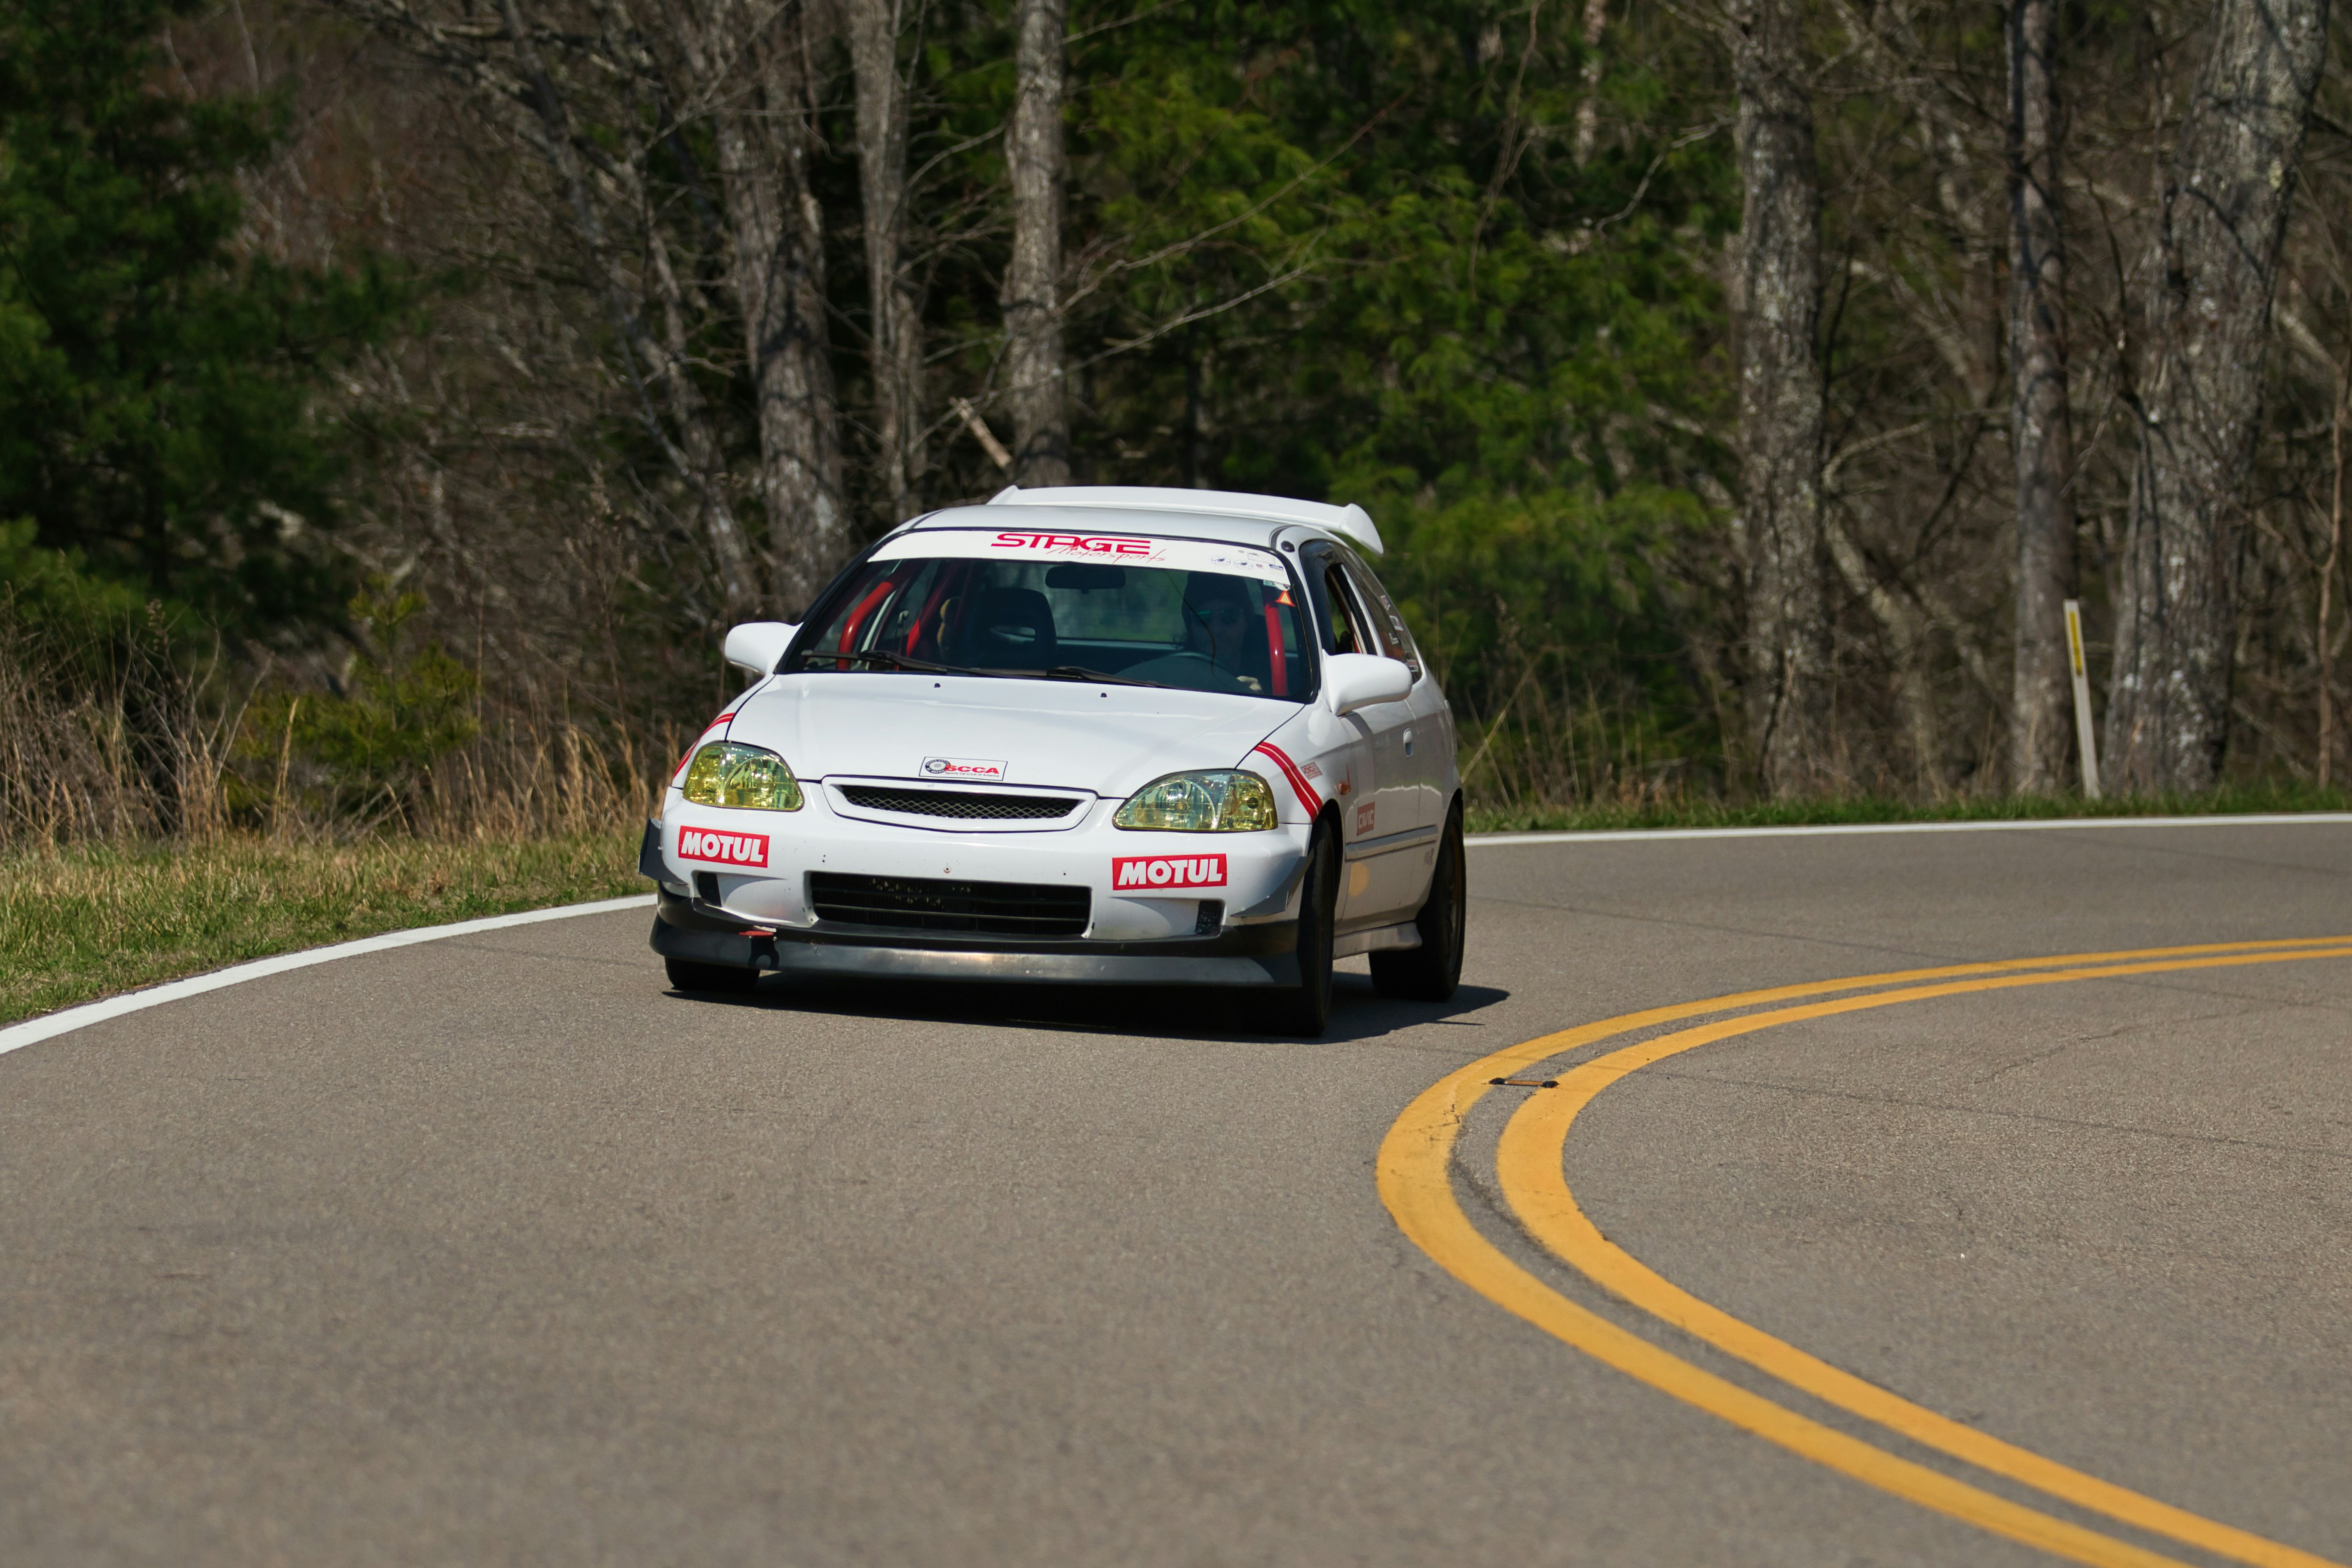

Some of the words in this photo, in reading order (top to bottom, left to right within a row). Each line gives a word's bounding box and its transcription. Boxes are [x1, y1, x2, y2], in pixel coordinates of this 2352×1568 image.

[991, 533, 1151, 554] STAGE
[1046, 543, 1167, 564] Motorsports
[945, 765, 999, 774] SCCA
[1358, 809, 1374, 829] CIVIC
[681, 831, 764, 862] MOTUL
[1118, 858, 1222, 885] MOTUL
